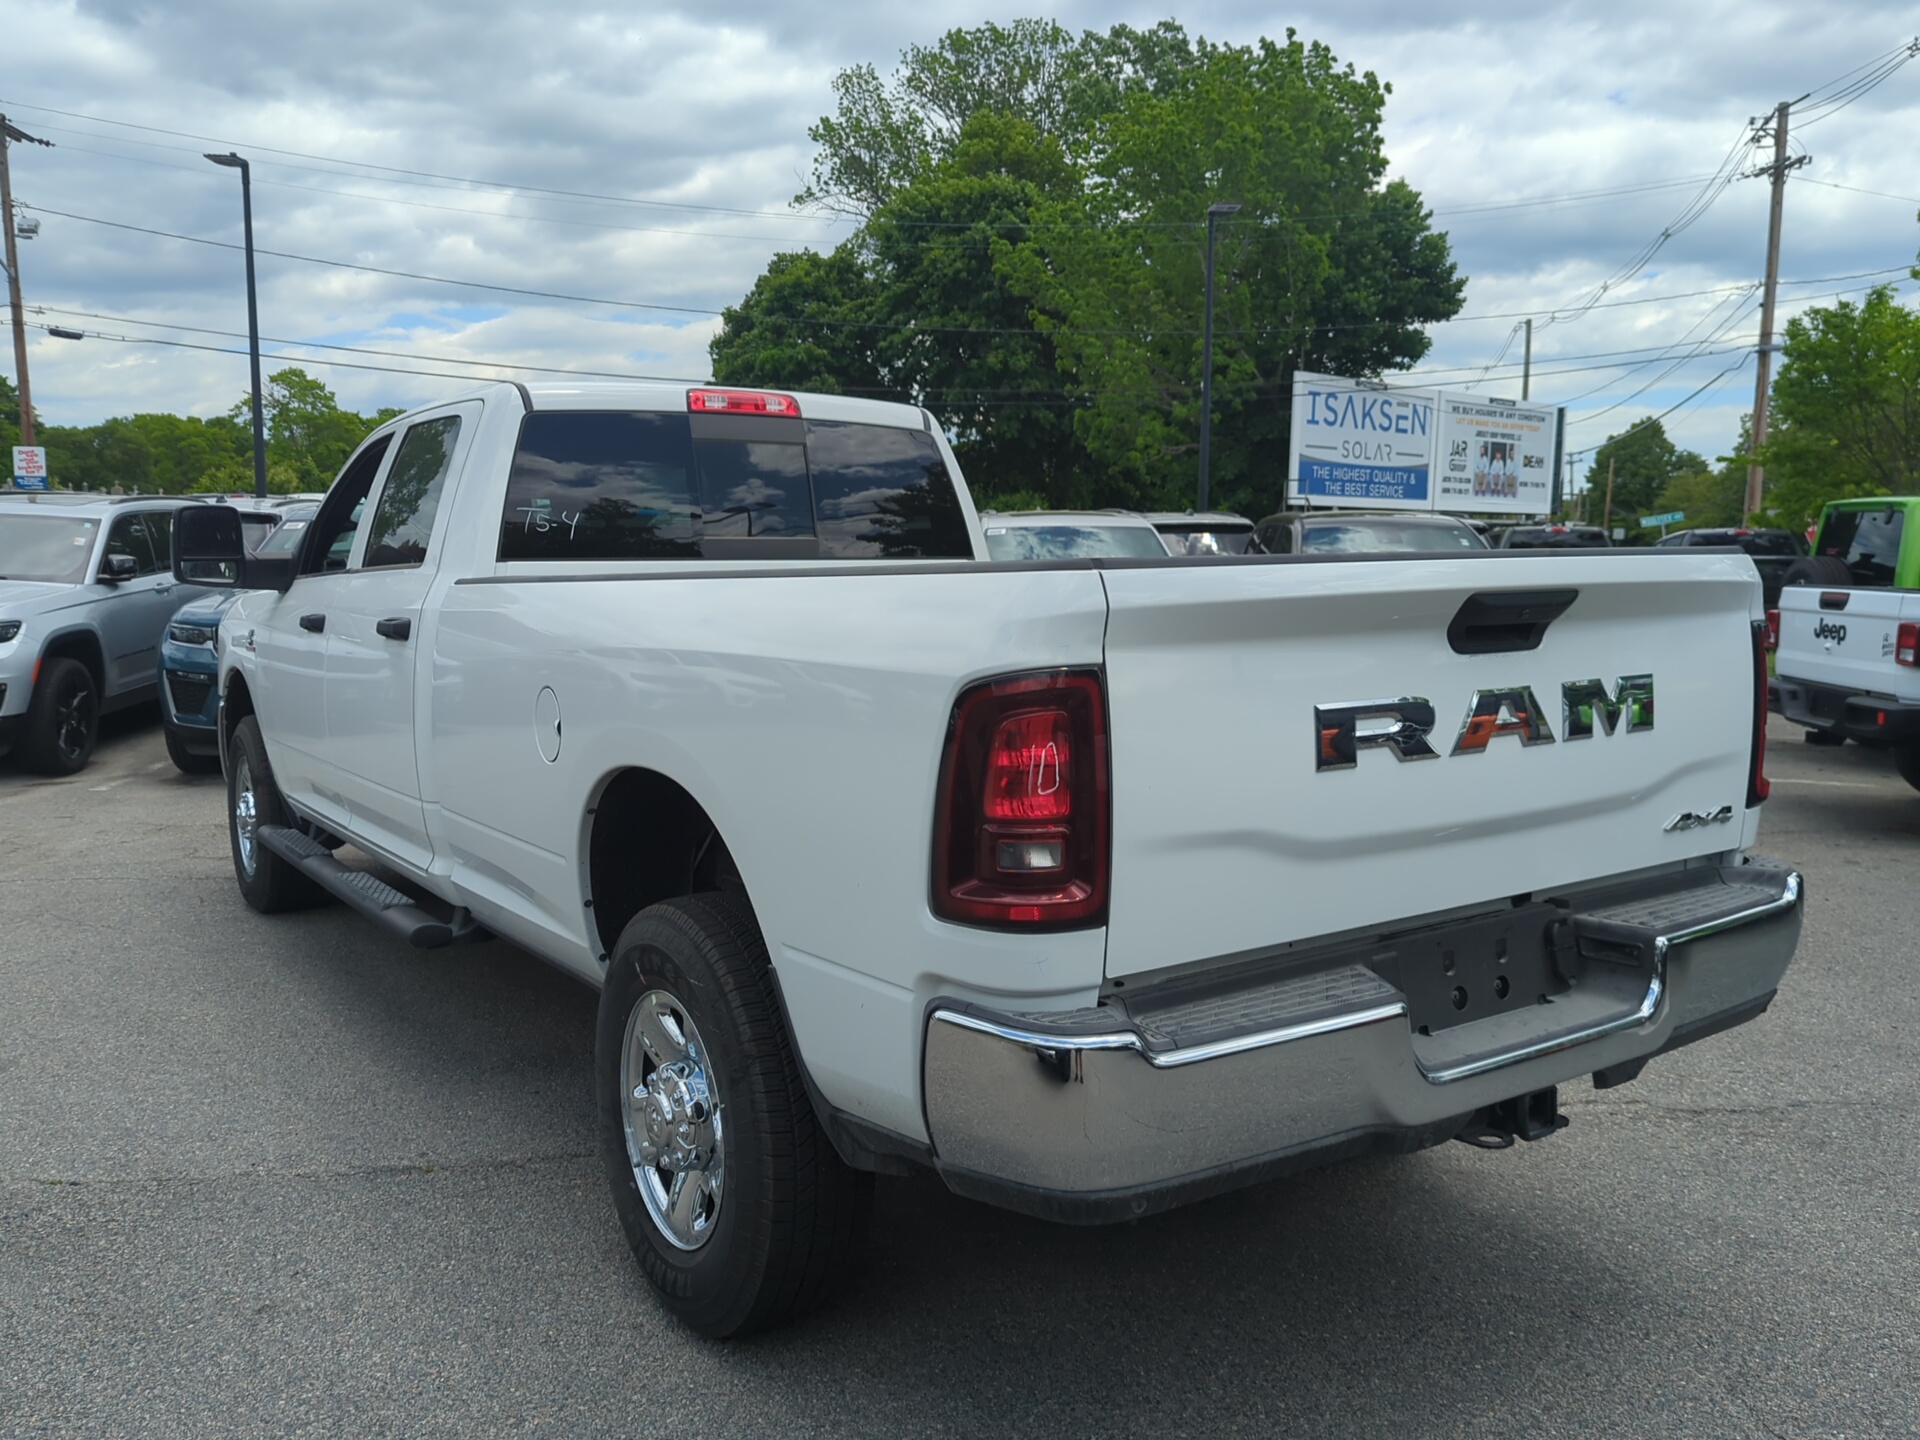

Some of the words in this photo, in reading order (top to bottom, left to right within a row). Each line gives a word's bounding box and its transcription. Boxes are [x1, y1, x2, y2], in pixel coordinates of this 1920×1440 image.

[1306, 390, 1428, 436] ISAKSEN
[1462, 406, 1474, 416] BUY
[1475, 408, 1498, 417] HOUSES
[1341, 439, 1392, 462] SOLAR
[1450, 440, 1468, 458] JAR
[1312, 465, 1331, 479] THE
[1332, 466, 1371, 482] HIGHEST
[1372, 469, 1408, 484] QUALITY
[1409, 472, 1417, 485] &
[1324, 481, 1343, 495] THE
[1344, 482, 1368, 496] BEST
[1369, 483, 1405, 499] SERVICE
[1814, 617, 1847, 646] Jeep
[1313, 673, 1655, 773] RAM
